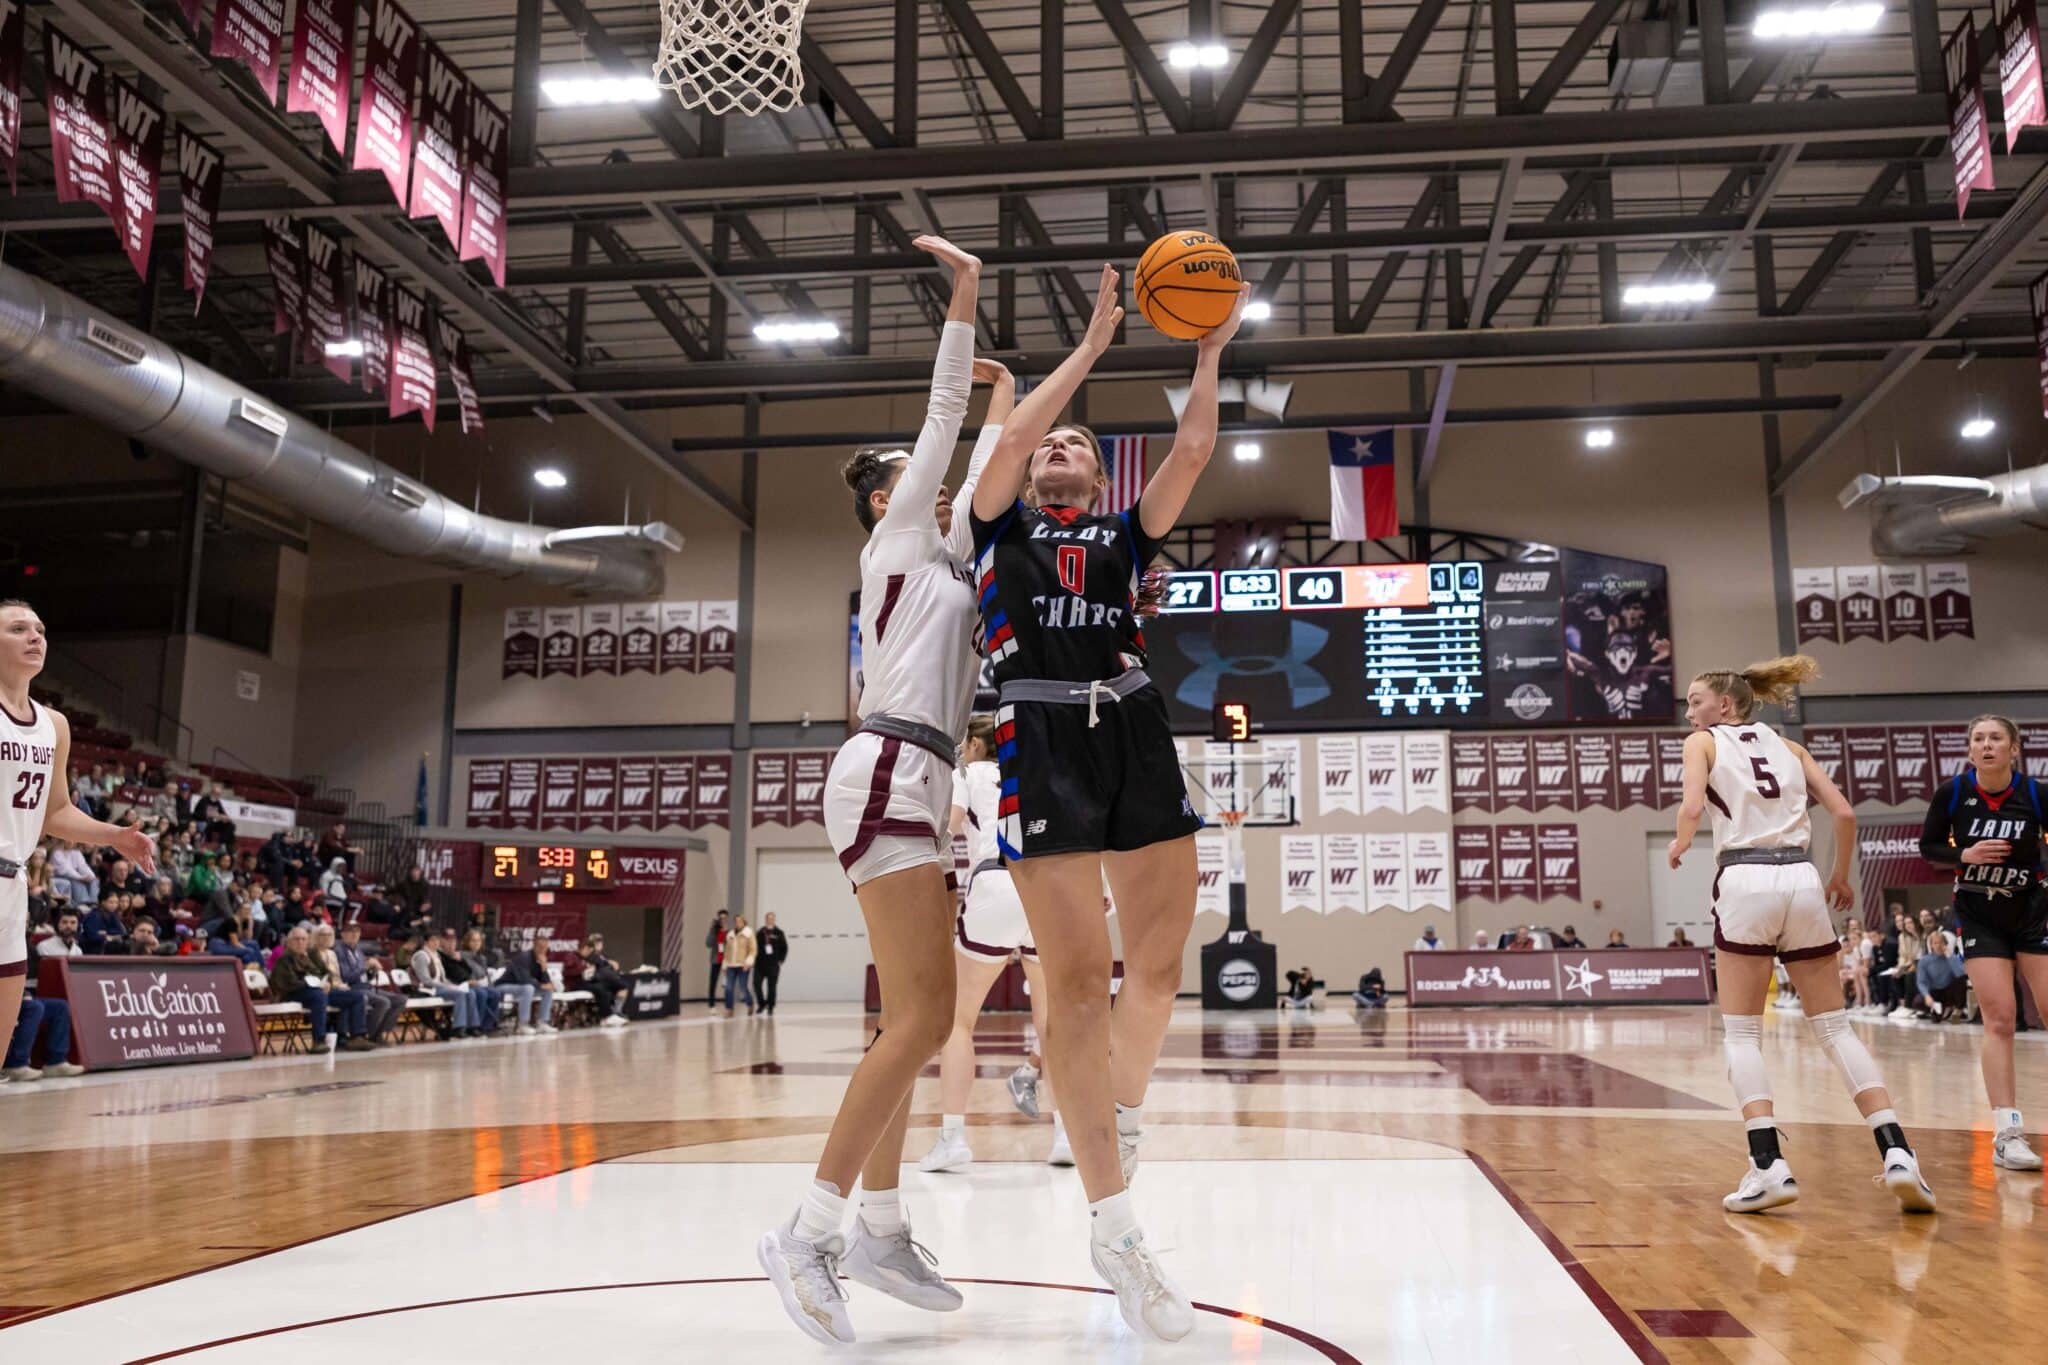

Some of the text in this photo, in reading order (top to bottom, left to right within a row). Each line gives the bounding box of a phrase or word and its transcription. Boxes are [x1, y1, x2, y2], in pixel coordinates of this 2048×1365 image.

[375, 0, 414, 59] WT
[52, 33, 98, 96] WT
[429, 53, 463, 112] WT
[119, 86, 160, 144] WT
[474, 97, 505, 154] WT
[181, 133, 218, 187] WT
[308, 224, 337, 271] WT
[356, 259, 384, 301] WT
[398, 288, 424, 330] WT
[1030, 522, 1118, 547] LADY
[1057, 545, 1087, 596] 0
[1169, 581, 1203, 605] 27
[1229, 576, 1272, 593] 5:33
[1298, 578, 1333, 600] 40
[1809, 601, 1824, 621] 8
[1847, 599, 1873, 619] 44
[1895, 598, 1915, 618] 10
[1948, 596, 1955, 616] 1
[550, 637, 573, 656] 33
[588, 635, 613, 654] 22
[628, 634, 651, 653] 52
[667, 632, 690, 652] 32
[708, 631, 728, 651] 14
[0, 741, 28, 762] ADY
[1369, 768, 1395, 785] WT
[1412, 767, 1439, 785] WT
[1456, 767, 1486, 786] WT
[1497, 767, 1527, 786] WT
[1538, 766, 1568, 785] WT
[1580, 765, 1610, 784] WT
[1621, 764, 1652, 783] WT
[1749, 756, 1781, 799] 5
[1854, 759, 1885, 779] WT
[1896, 758, 1928, 778] WT
[1327, 770, 1352, 786] WT
[12, 771, 45, 810] 23
[472, 791, 499, 809] WT
[508, 789, 537, 807] WT
[547, 788, 575, 807] WT
[584, 788, 612, 806] WT
[622, 787, 651, 806] WT
[661, 786, 689, 805] WT
[699, 785, 727, 804] WT
[757, 783, 786, 801] WT
[796, 782, 824, 801] WT
[1968, 818, 2027, 840] LADY
[1862, 838, 1920, 855] PARKE
[539, 847, 575, 867] 5:33
[619, 857, 678, 874] VEXUS
[494, 857, 609, 879] 27 40
[1331, 868, 1358, 885] WT
[1374, 869, 1400, 885] WT
[1415, 868, 1442, 885] WT
[1461, 859, 1490, 878] WT
[1502, 858, 1532, 877] WT
[1544, 858, 1575, 877] WT
[1964, 864, 2030, 886] CHAPS
[565, 873, 574, 888] 3
[1288, 870, 1315, 887] WT
[1228, 930, 1248, 944] WT
[1222, 975, 1258, 986] PEPSI
[1507, 980, 1551, 990] AUTOS
[110, 1018, 226, 1040] credit union
[122, 1045, 152, 1061] Learn
[179, 1041, 197, 1055] Live
